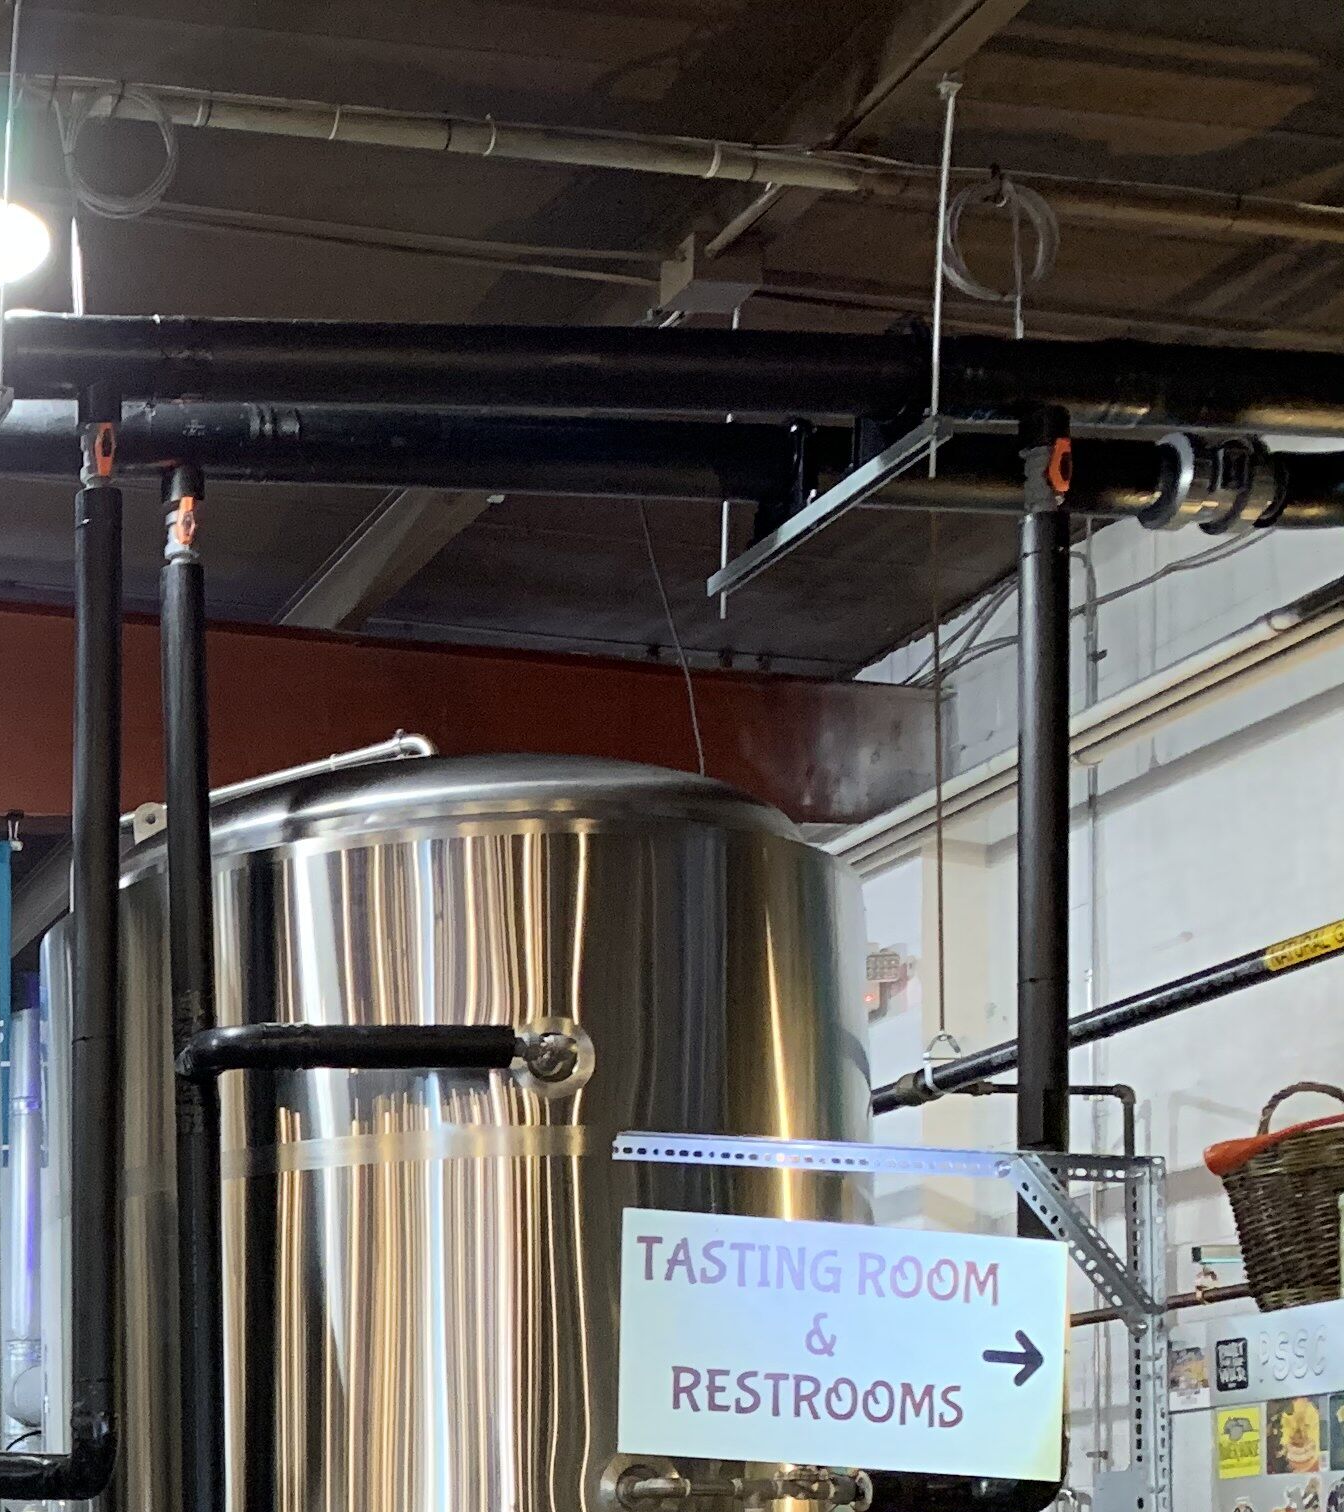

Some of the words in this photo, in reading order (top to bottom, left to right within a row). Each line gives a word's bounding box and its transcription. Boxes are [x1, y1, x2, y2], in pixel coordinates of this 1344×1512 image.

[636, 1235, 843, 1294] TASTING
[857, 1251, 1000, 1306] ROOM
[805, 1312, 837, 1357] &
[671, 1365, 965, 1429] RESTROOMS
